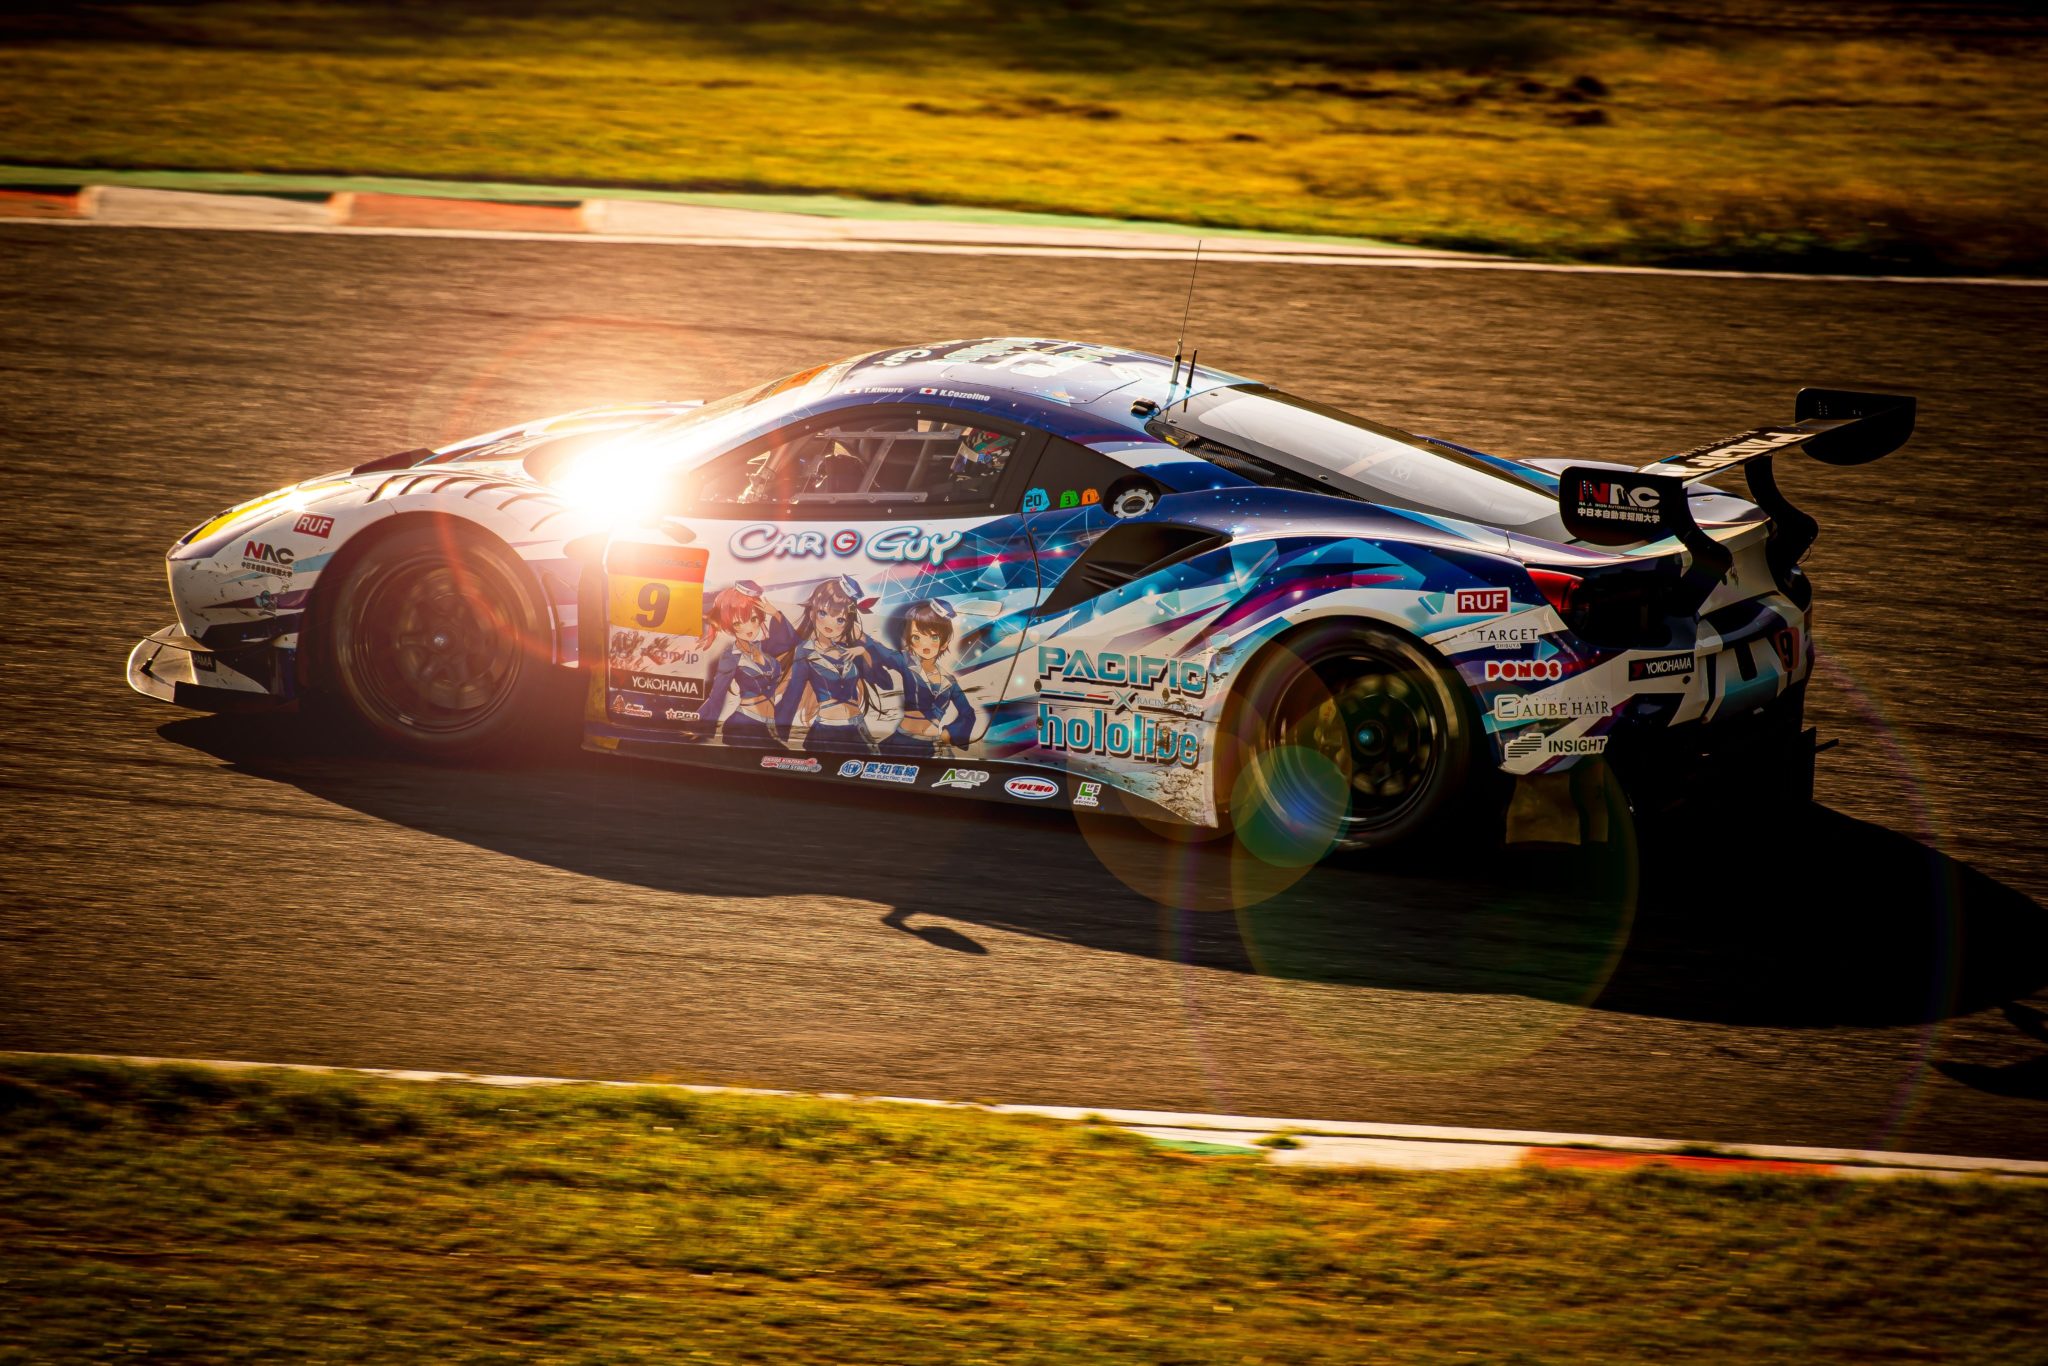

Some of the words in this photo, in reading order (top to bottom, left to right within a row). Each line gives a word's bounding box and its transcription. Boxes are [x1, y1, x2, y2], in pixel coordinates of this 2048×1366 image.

[939, 389, 990, 402] K.Cozzolino
[1026, 494, 1042, 507] 20
[1064, 495, 1072, 506] 3
[1578, 479, 1661, 508] NAC
[297, 516, 332, 534] RUF
[243, 540, 295, 564] NAC
[728, 523, 824, 558] CAR
[865, 526, 962, 565] GUY
[635, 582, 671, 628] 9
[1460, 593, 1505, 610] RUF
[1476, 628, 1538, 642] TARGET
[1038, 645, 1207, 694] PACIFIC
[1488, 662, 1559, 678] PONOS
[1645, 657, 1692, 675] YOKOHAMA
[632, 675, 699, 695] YOKOHAMA
[1522, 702, 1568, 717] AUBE
[1572, 701, 1609, 716] HAIR
[1038, 702, 1199, 767] hololive
[1548, 738, 1606, 753] INSIGHT
